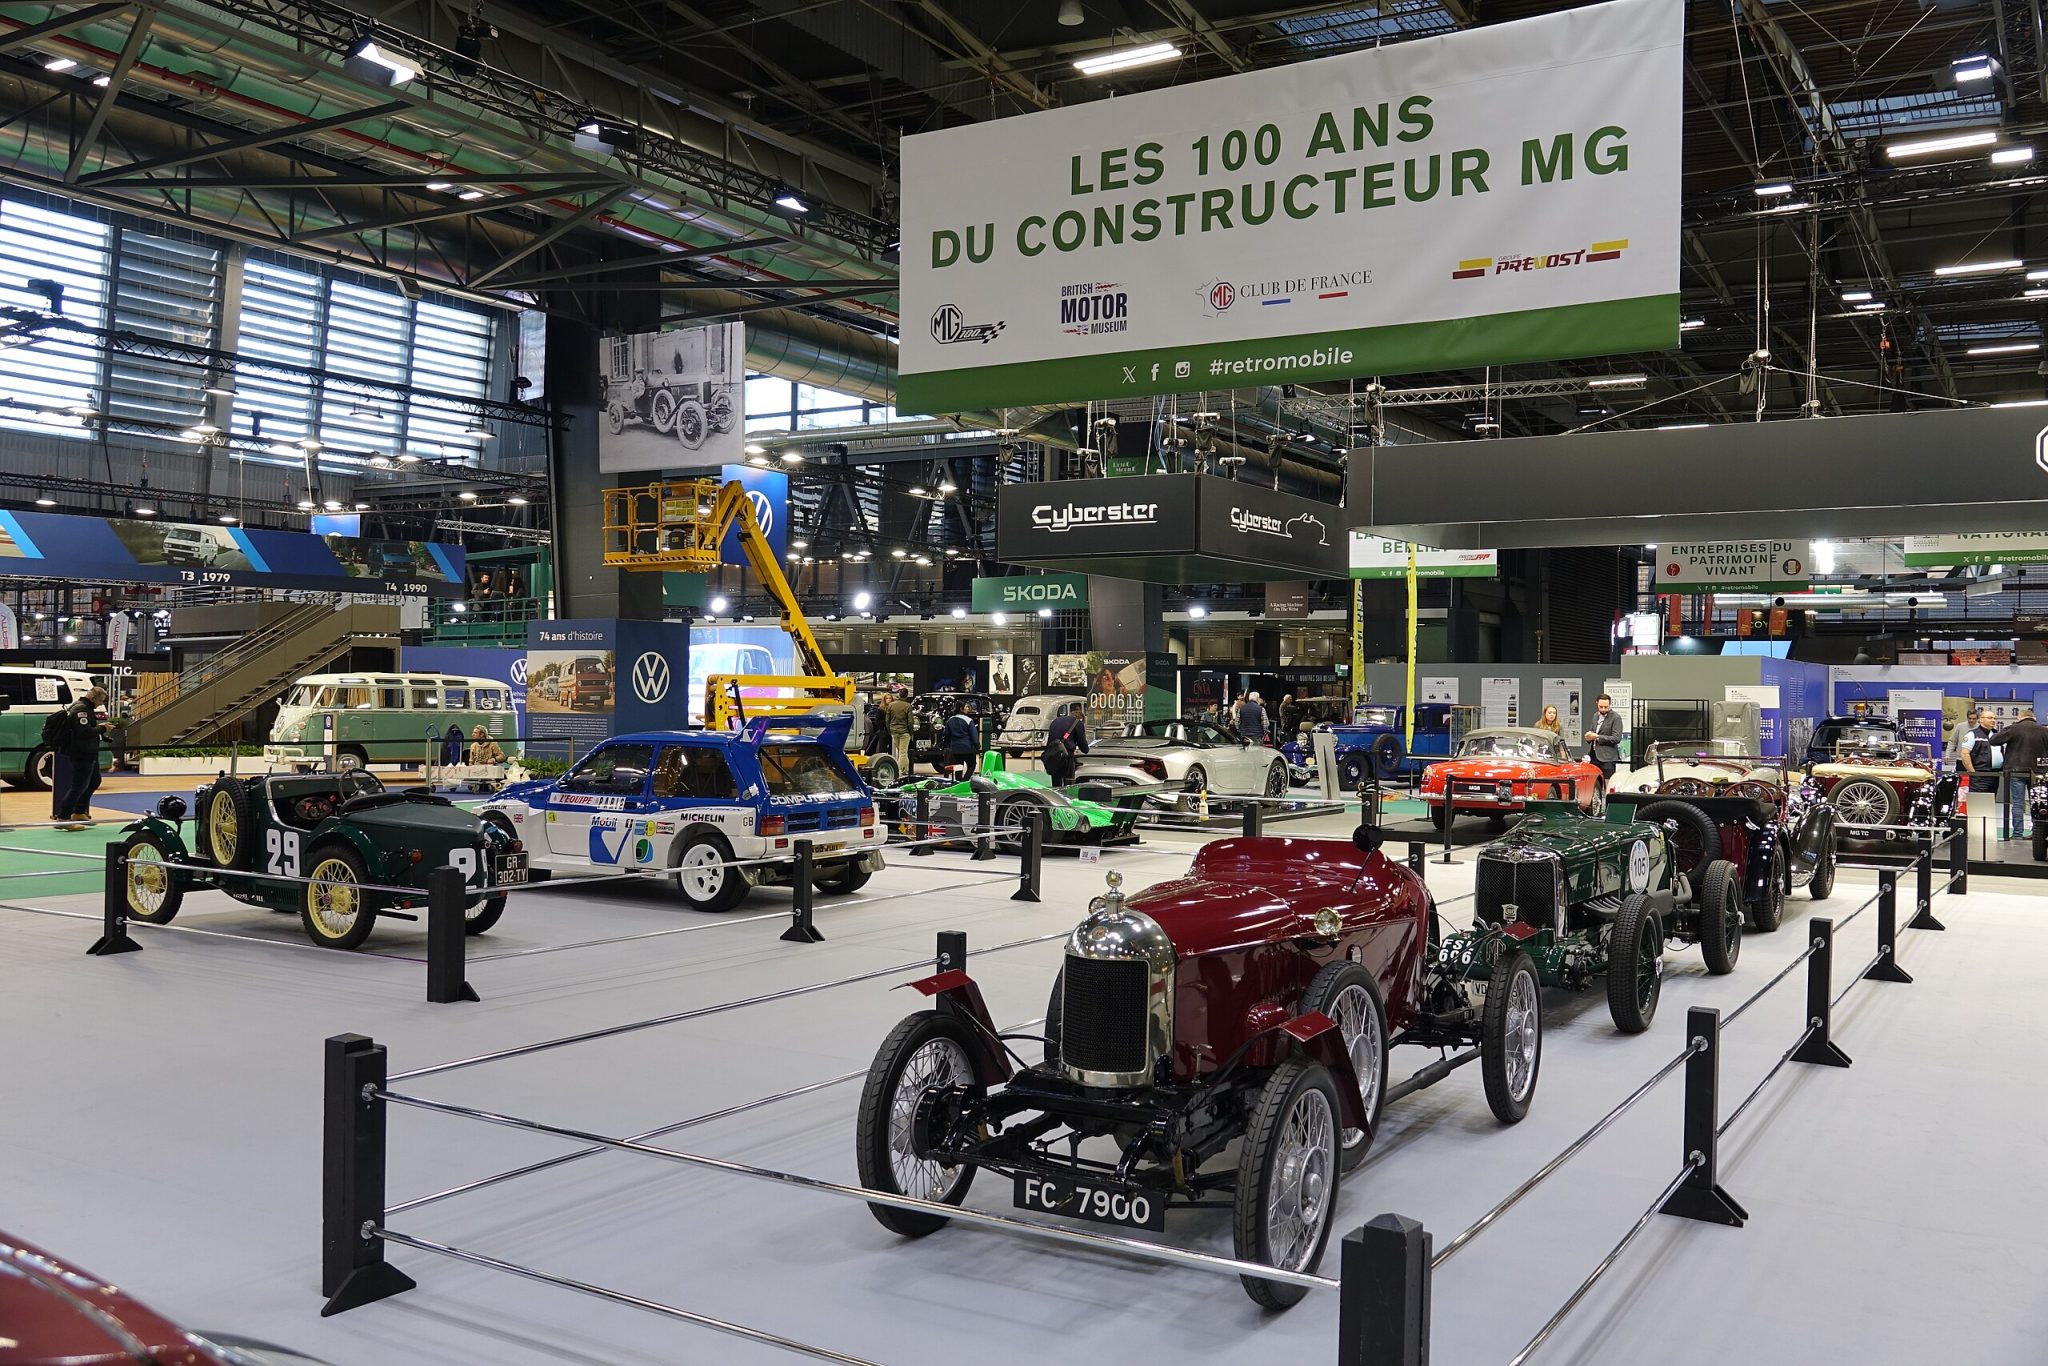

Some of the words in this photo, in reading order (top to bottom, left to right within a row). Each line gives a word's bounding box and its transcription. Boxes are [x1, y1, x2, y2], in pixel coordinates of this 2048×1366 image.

[1071, 142, 1165, 196] LES
[1191, 123, 1282, 176] 100
[1305, 95, 1434, 159] ANS
[931, 222, 995, 269] DU
[1016, 148, 1490, 257] CONSTRUCTEUR
[1521, 125, 1629, 187] MG
[1498, 253, 1521, 261] GROUPE
[1061, 283, 1093, 297] BRITISH
[1212, 284, 1234, 308] MG
[1240, 281, 1280, 298] CLUB
[1285, 279, 1306, 293] DE
[1311, 270, 1373, 290] FRANCE
[1061, 293, 1128, 324] MOTOR
[932, 305, 962, 343] MG
[1090, 320, 1127, 335] MUSEUM
[1209, 347, 1354, 376] #retromobile
[1032, 503, 1158, 528] Cyberster
[1231, 507, 1282, 531] Cyberster
[1671, 543, 1766, 555] ENTREPRISES
[1773, 543, 1792, 551] DU
[1690, 554, 1777, 565] PATRIMOINE
[180, 571, 195, 581] T3
[202, 572, 231, 583] 1979
[1706, 565, 1756, 576] VIVANT
[385, 582, 397, 592] T4
[403, 583, 428, 593] 1990
[539, 632, 550, 641] 74
[551, 633, 566, 641] ans
[567, 631, 603, 641] d'histoire
[591, 816, 618, 826] Mobil
[680, 813, 725, 823] MICHELIN
[743, 817, 754, 827] GB
[266, 829, 300, 877] 29
[1634, 857, 1645, 877] 105
[1025, 1178, 1057, 1208] FC
[1075, 1187, 1150, 1224] 7900
